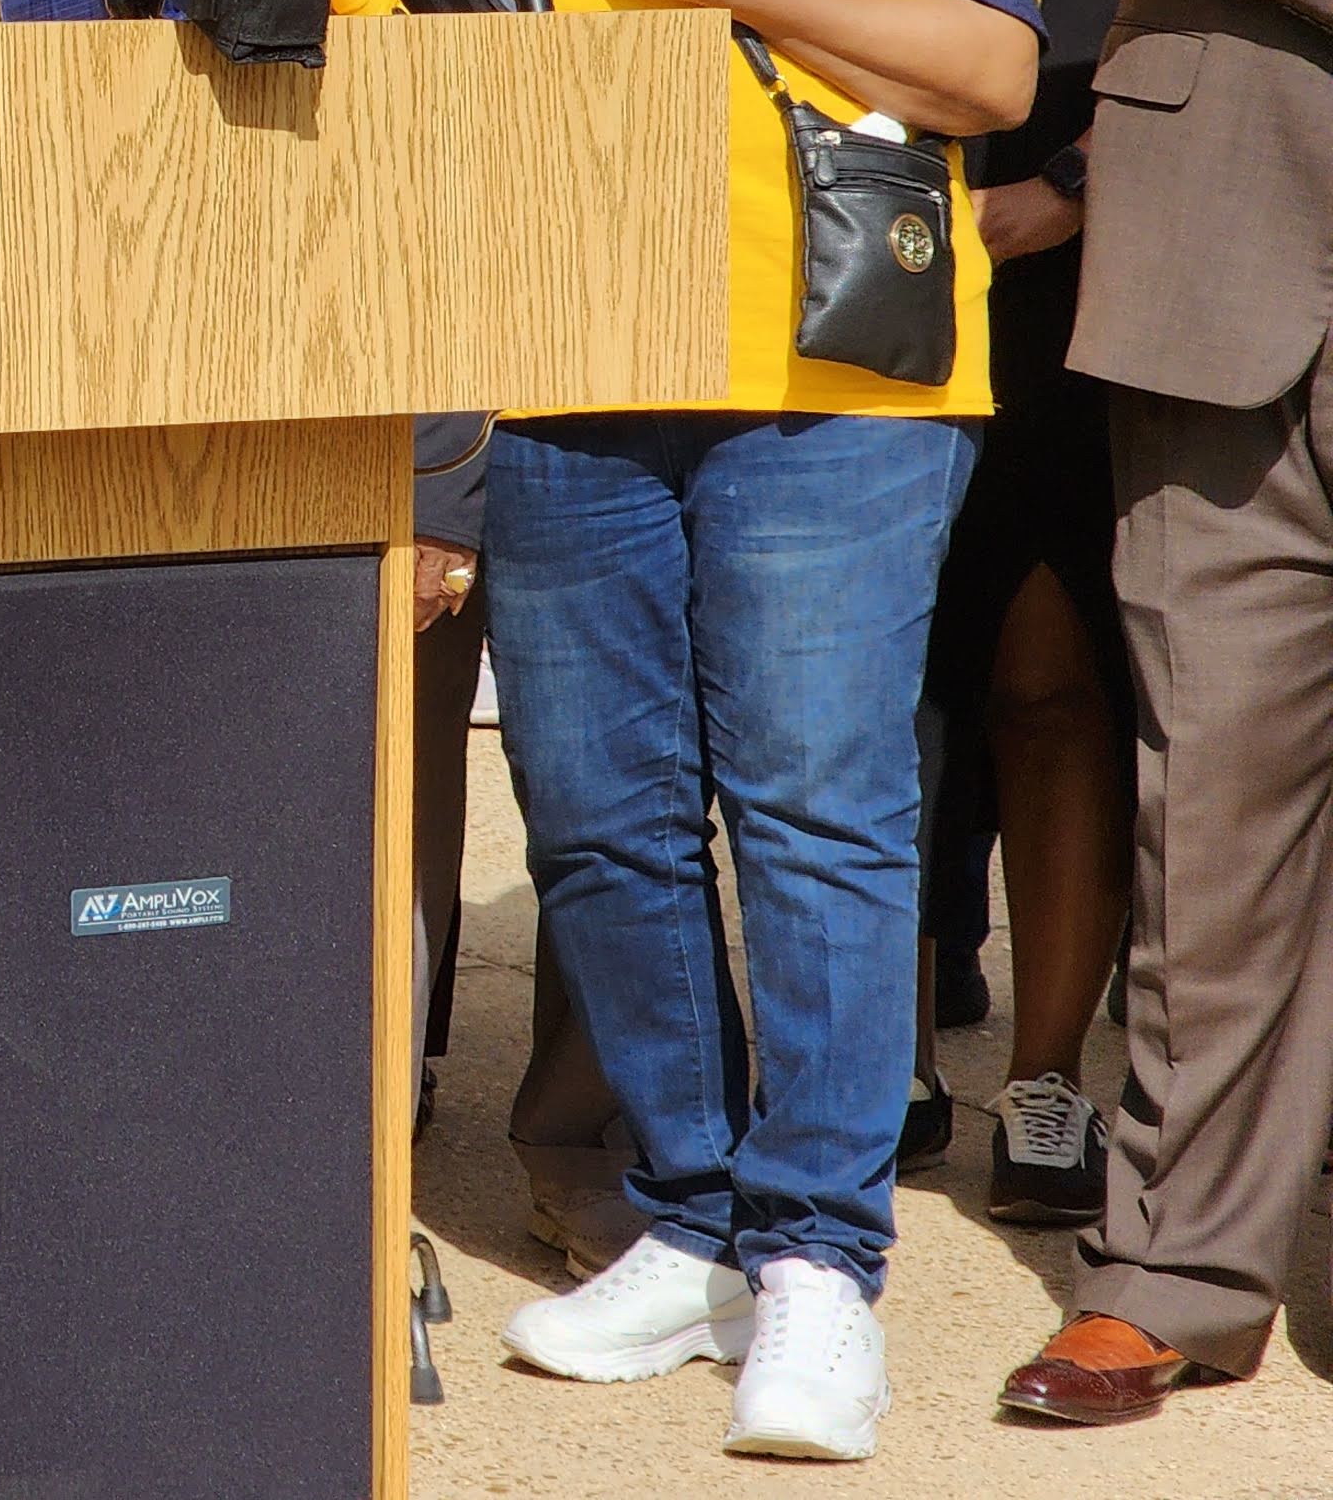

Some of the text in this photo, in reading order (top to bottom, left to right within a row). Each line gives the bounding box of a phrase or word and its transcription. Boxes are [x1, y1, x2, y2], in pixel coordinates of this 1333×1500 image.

[78, 886, 221, 921] AV AMPLIVOX
[162, 906, 191, 916] SOUND
